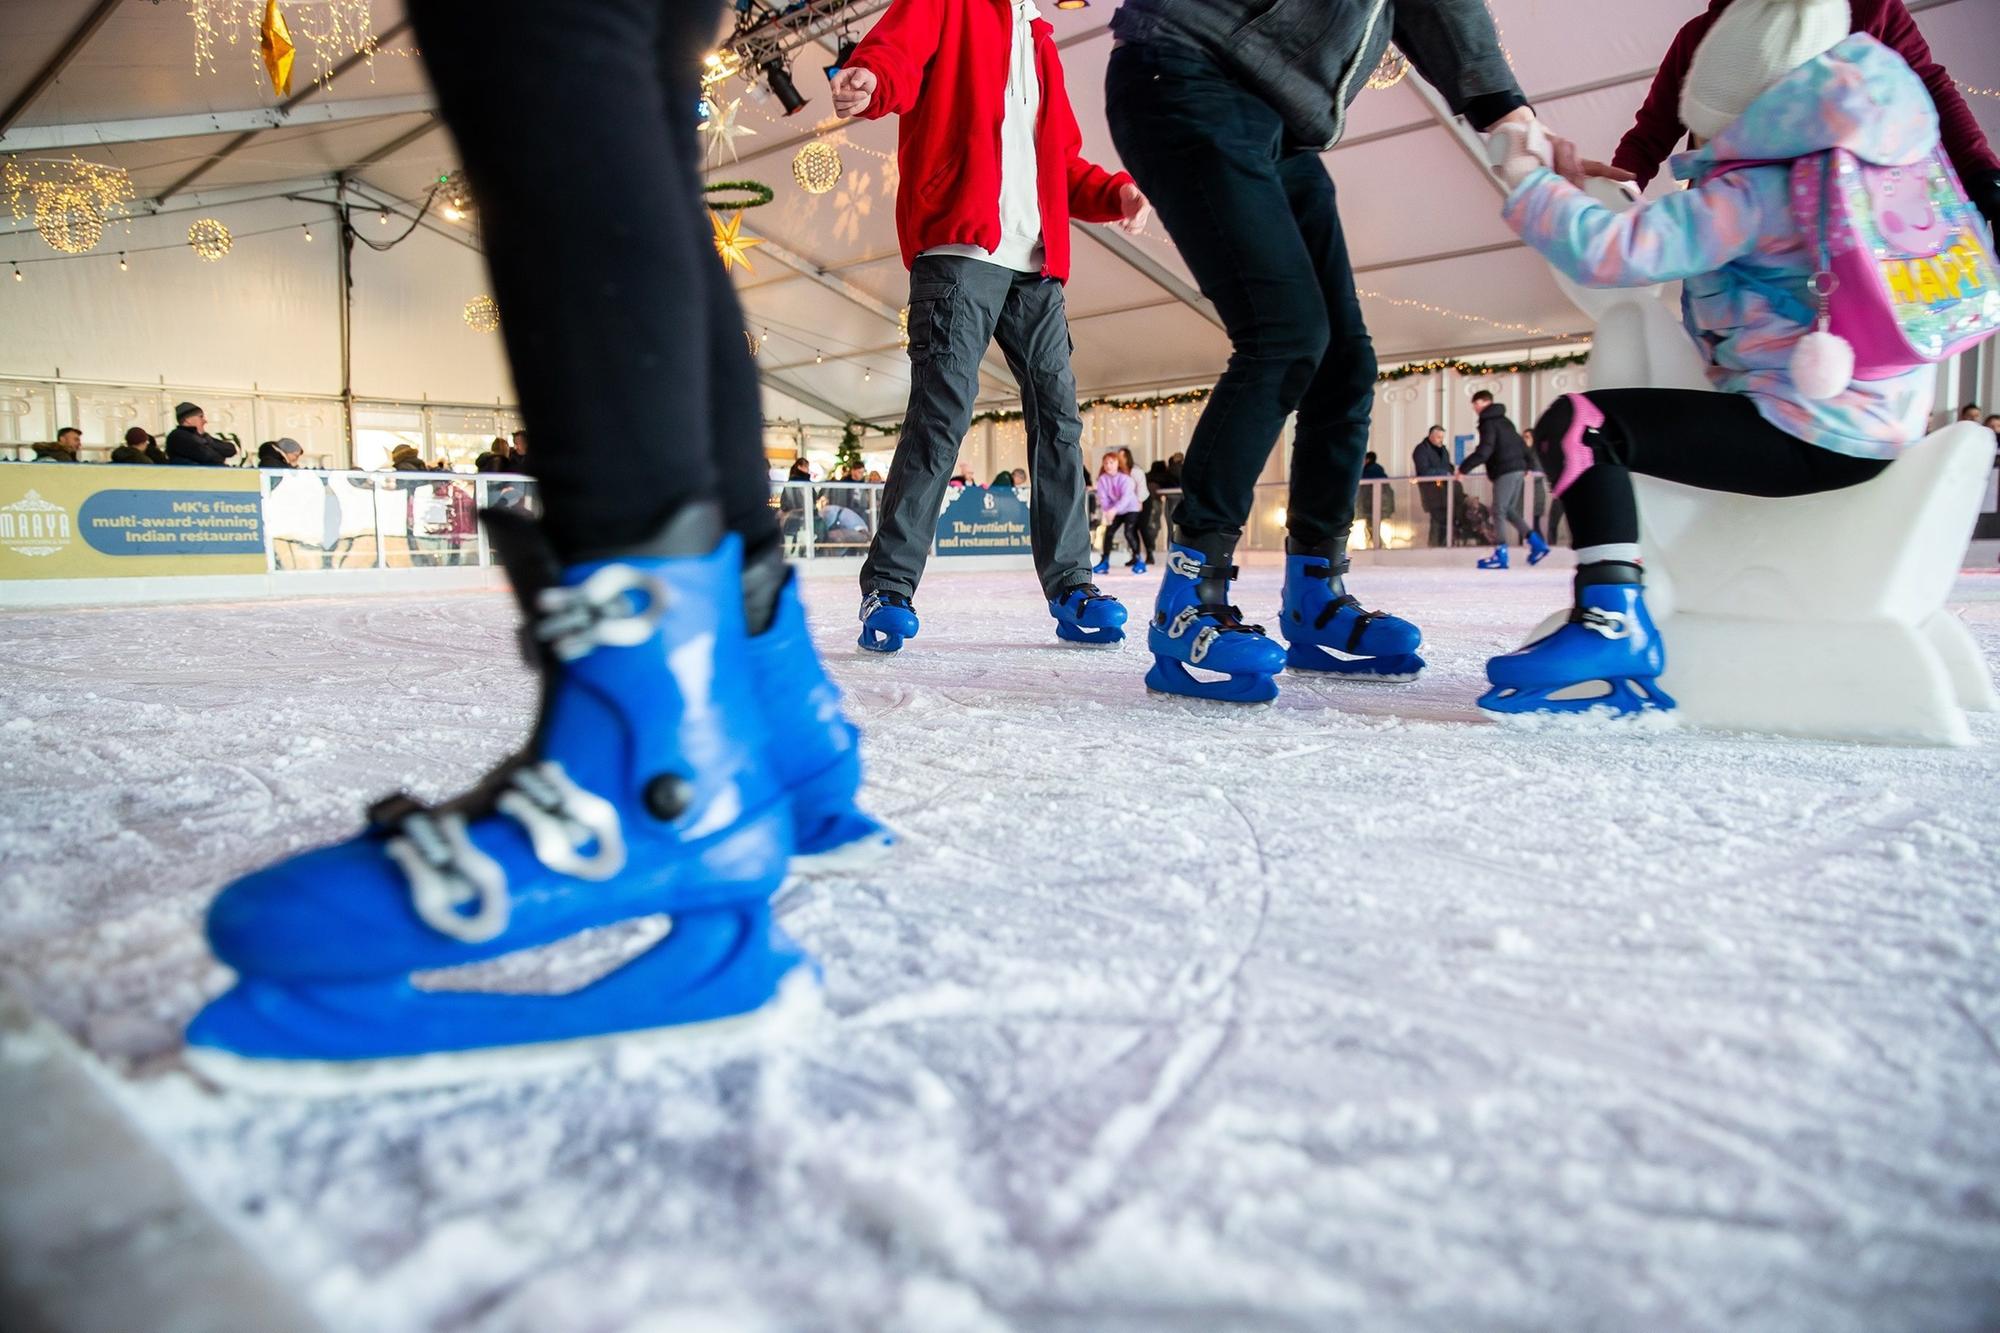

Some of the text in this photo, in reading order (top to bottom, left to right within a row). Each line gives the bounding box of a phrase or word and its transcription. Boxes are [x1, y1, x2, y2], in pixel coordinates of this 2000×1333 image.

[172, 501, 257, 513] MK's finest
[0, 513, 70, 538] MAAYA
[92, 515, 258, 529] multi-award-winning
[952, 521, 971, 533] The
[126, 530, 259, 542] Indian restaurant
[939, 535, 959, 547] and
[960, 537, 1008, 547] restaurant
